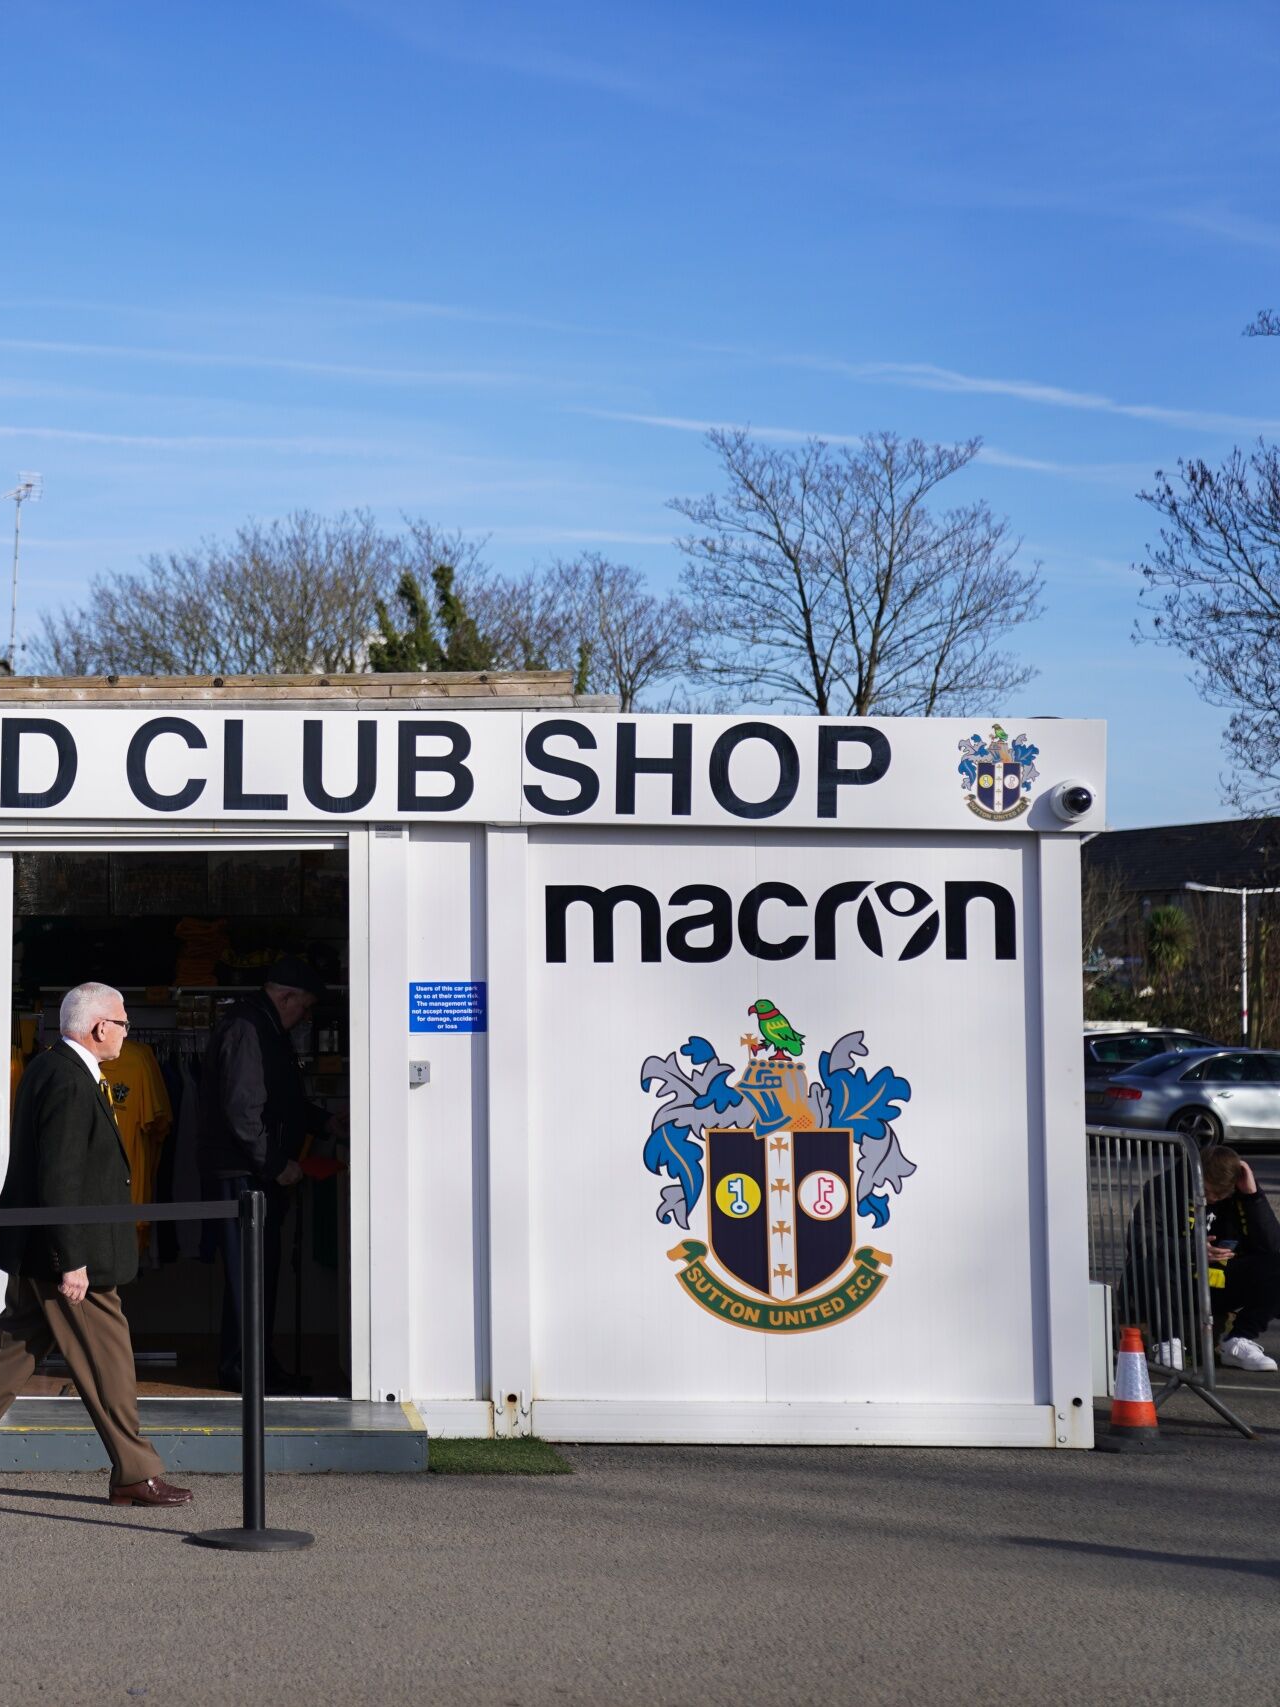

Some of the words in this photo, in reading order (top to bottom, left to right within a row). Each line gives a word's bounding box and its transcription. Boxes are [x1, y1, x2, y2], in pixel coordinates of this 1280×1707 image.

[126, 716, 474, 814] CLUB
[523, 719, 892, 820] SHOP
[544, 880, 1017, 964] macron
[686, 1266, 760, 1323] SUTTON
[769, 1300, 846, 1326] UNITED
[845, 1273, 876, 1302] F.C.
